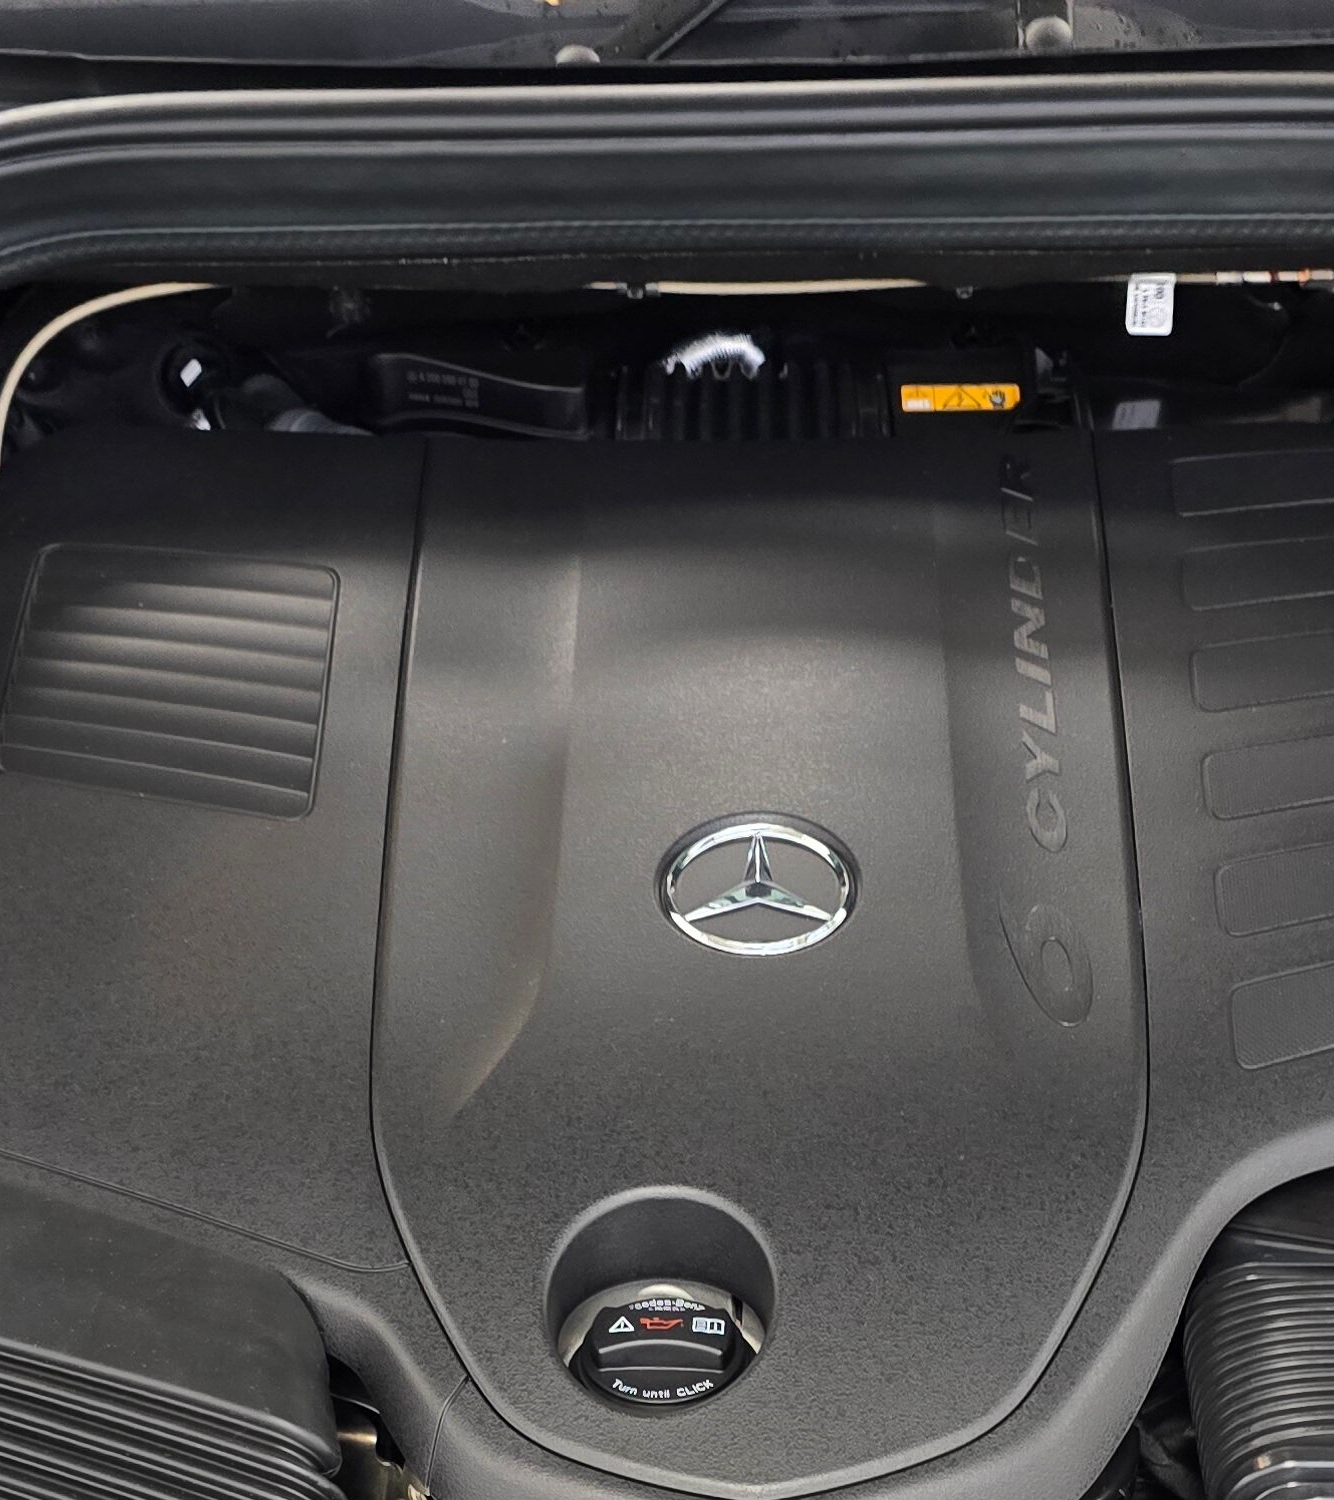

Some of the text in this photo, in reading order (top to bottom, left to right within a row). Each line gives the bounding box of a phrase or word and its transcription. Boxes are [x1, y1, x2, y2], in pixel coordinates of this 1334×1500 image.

[997, 455, 1094, 1028] 6 CYLINDER
[612, 1378, 714, 1399] Turn until CLICK
